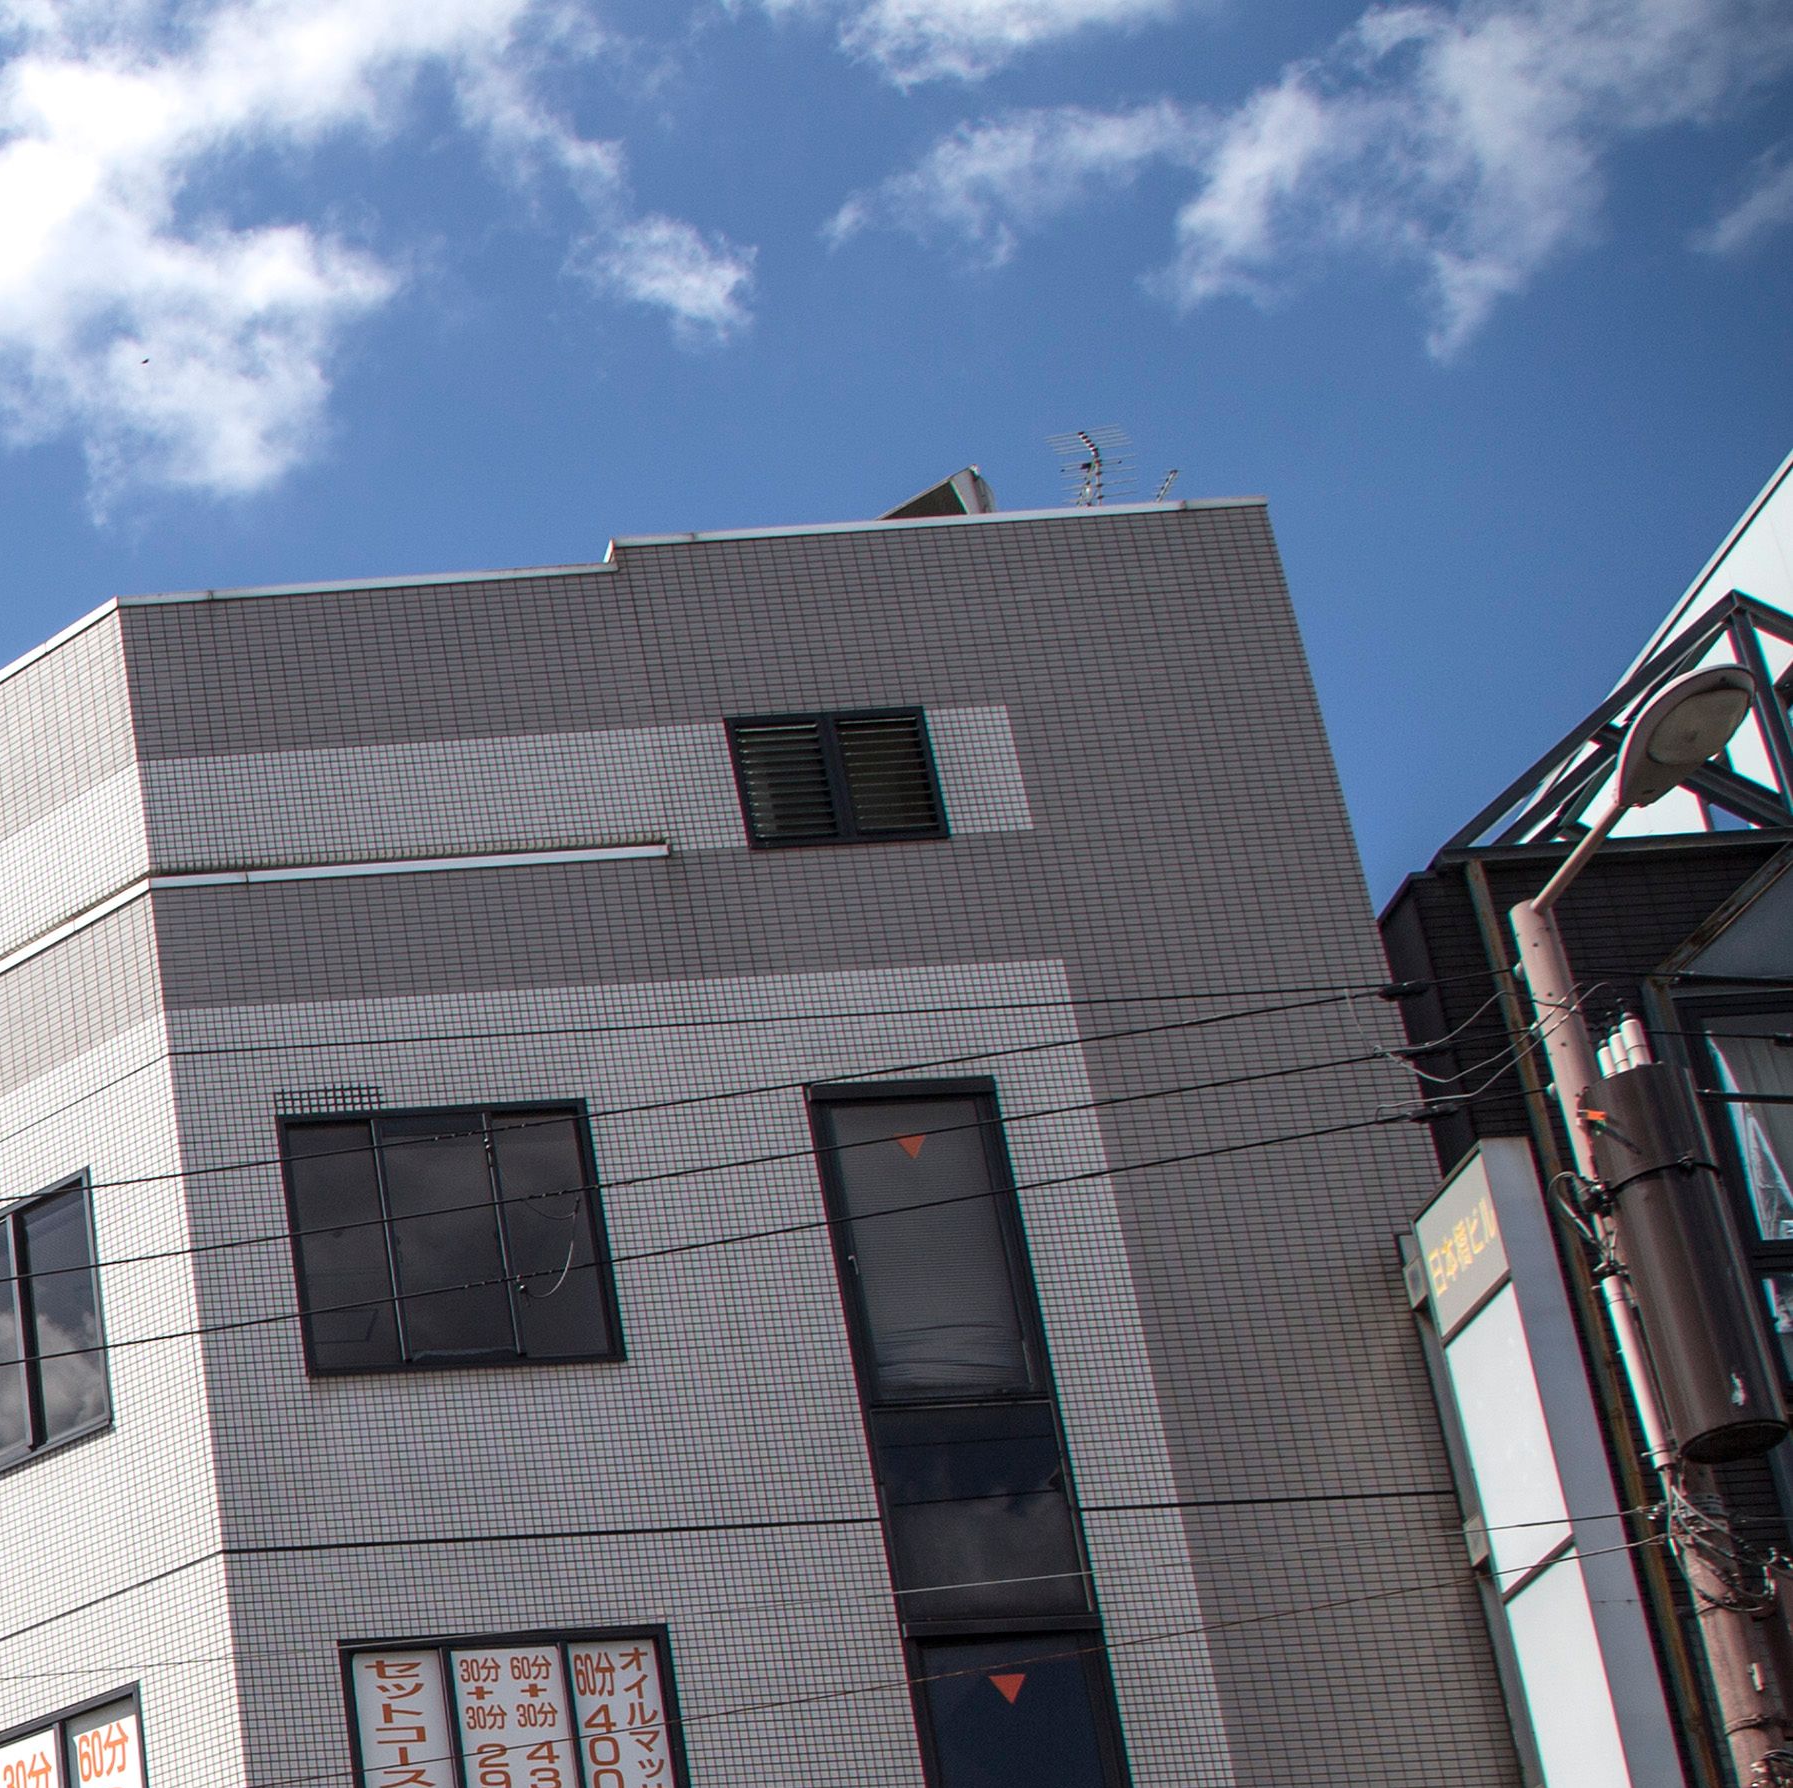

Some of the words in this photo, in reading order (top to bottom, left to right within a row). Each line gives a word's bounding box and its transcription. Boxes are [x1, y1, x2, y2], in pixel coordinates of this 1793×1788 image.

[460, 1657, 501, 1683] 30分
[510, 1655, 552, 1680] 60分
[573, 1652, 615, 1697] 60分
[466, 1704, 507, 1730] 30分
[516, 1702, 557, 1728] 30分
[77, 1722, 130, 1783] 60分
